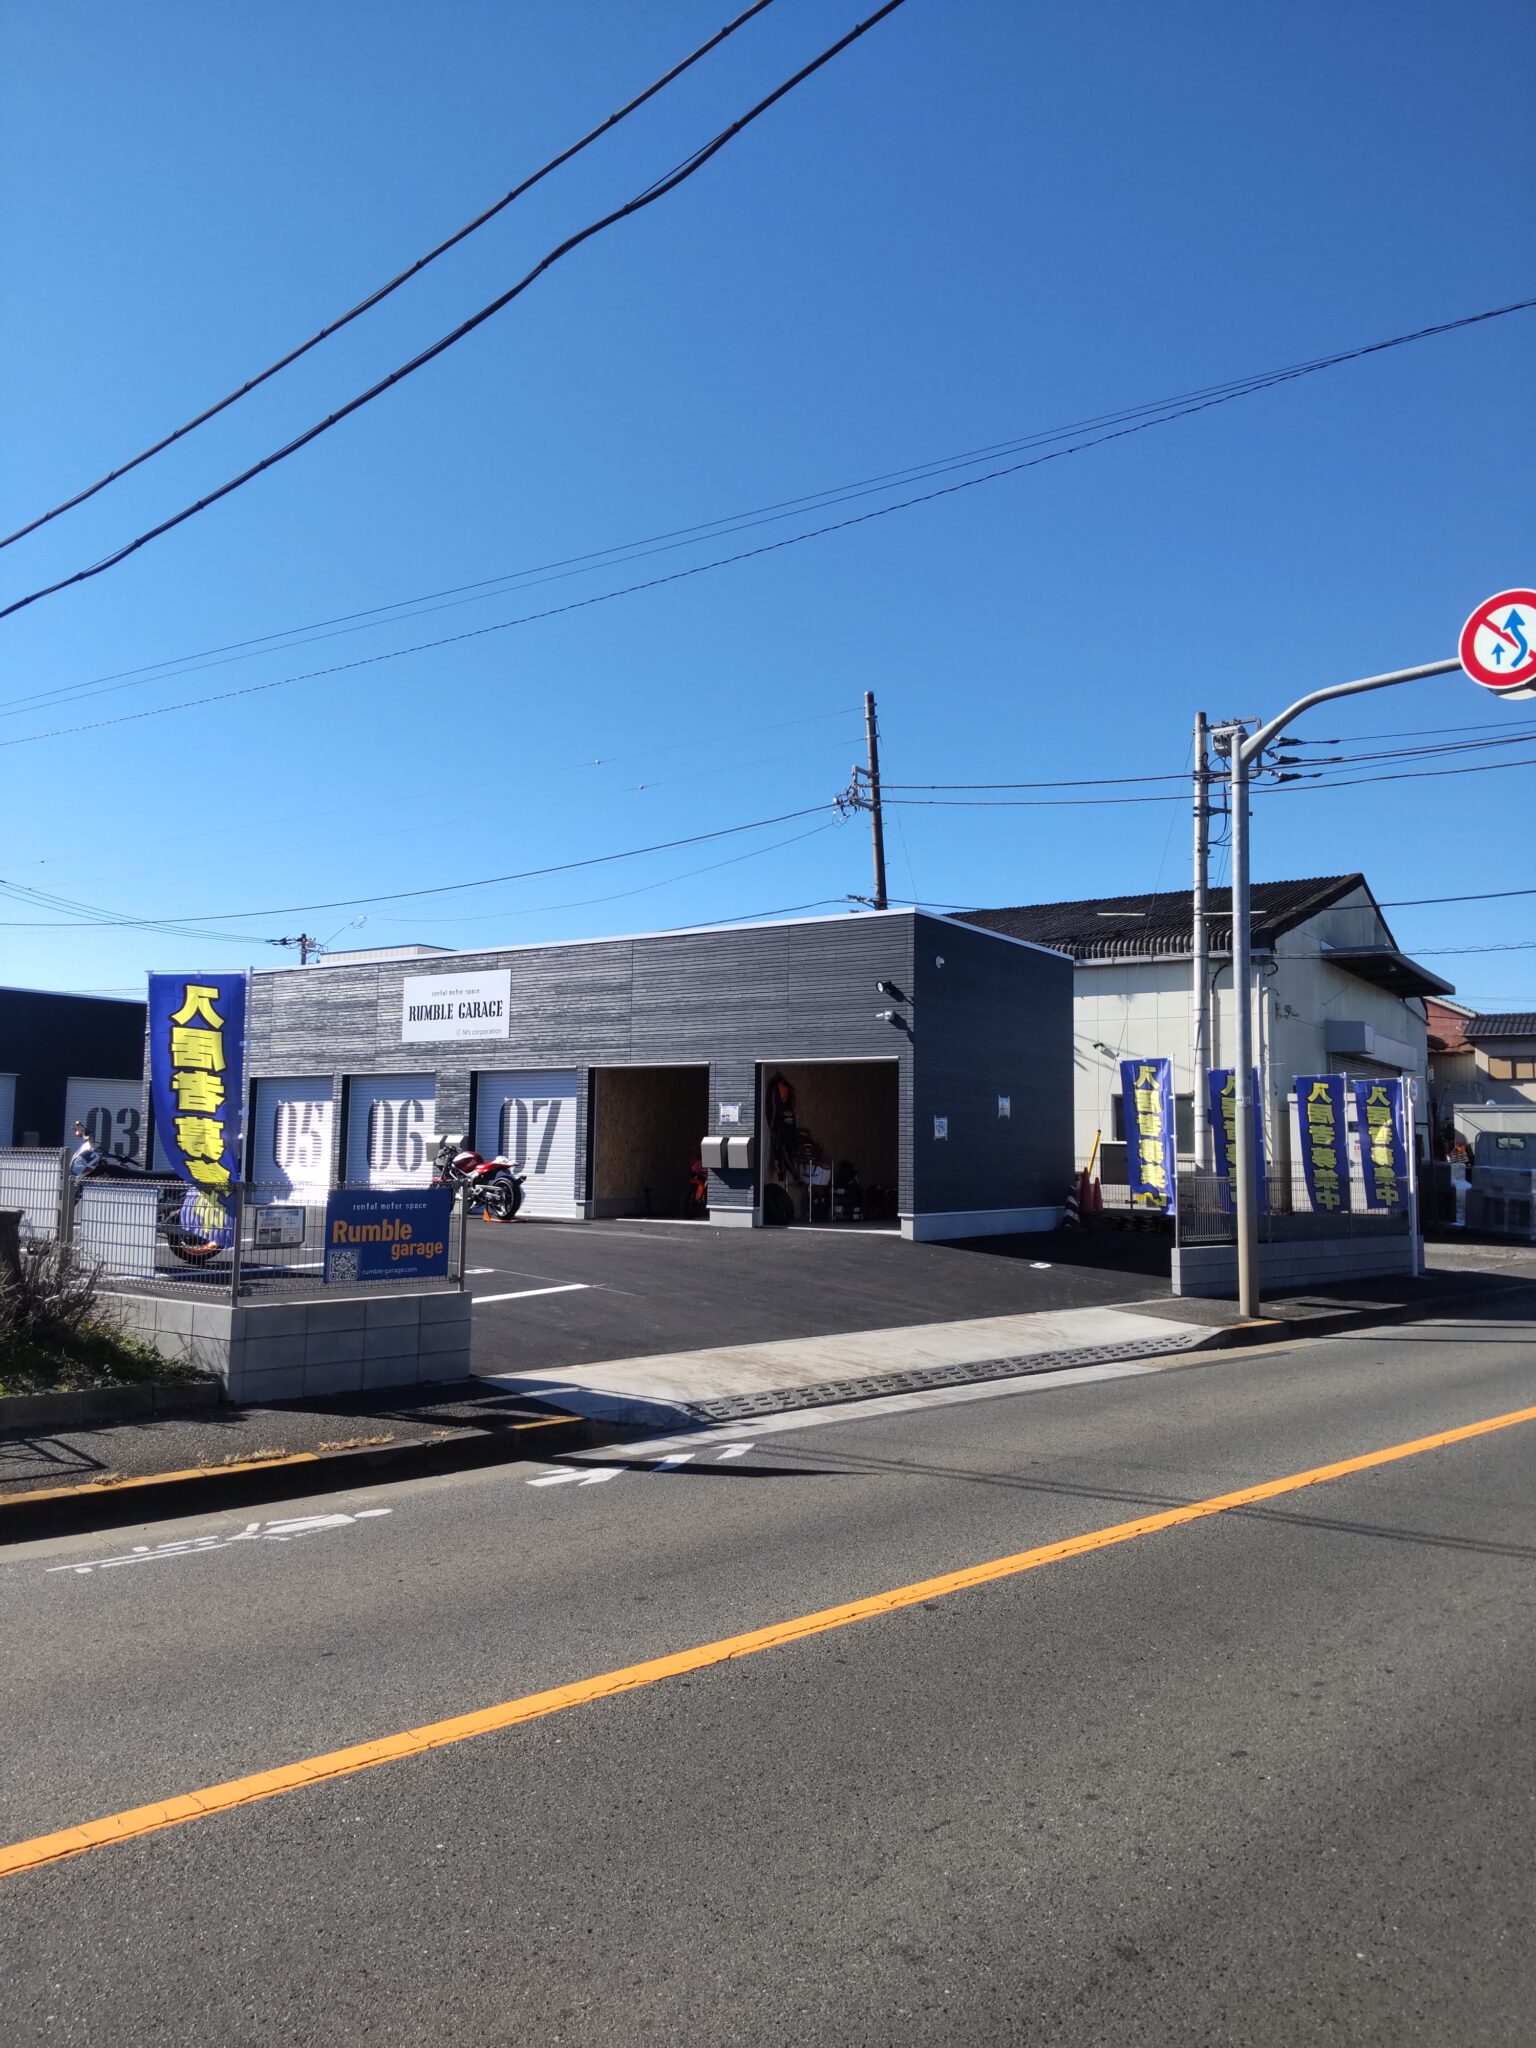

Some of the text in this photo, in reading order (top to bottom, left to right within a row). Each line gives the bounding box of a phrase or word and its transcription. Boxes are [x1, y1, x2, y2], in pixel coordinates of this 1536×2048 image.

[409, 1000, 503, 1021] RUMBLE GARAGE
[86, 1107, 141, 1158] 03
[272, 1101, 324, 1168] 05
[367, 1099, 425, 1172] 06
[498, 1098, 562, 1174] 07
[353, 1201, 427, 1210] rental motor space
[332, 1218, 412, 1243] Rumble
[391, 1241, 443, 1261] garage
[362, 1266, 418, 1275] rumble-garage.com
